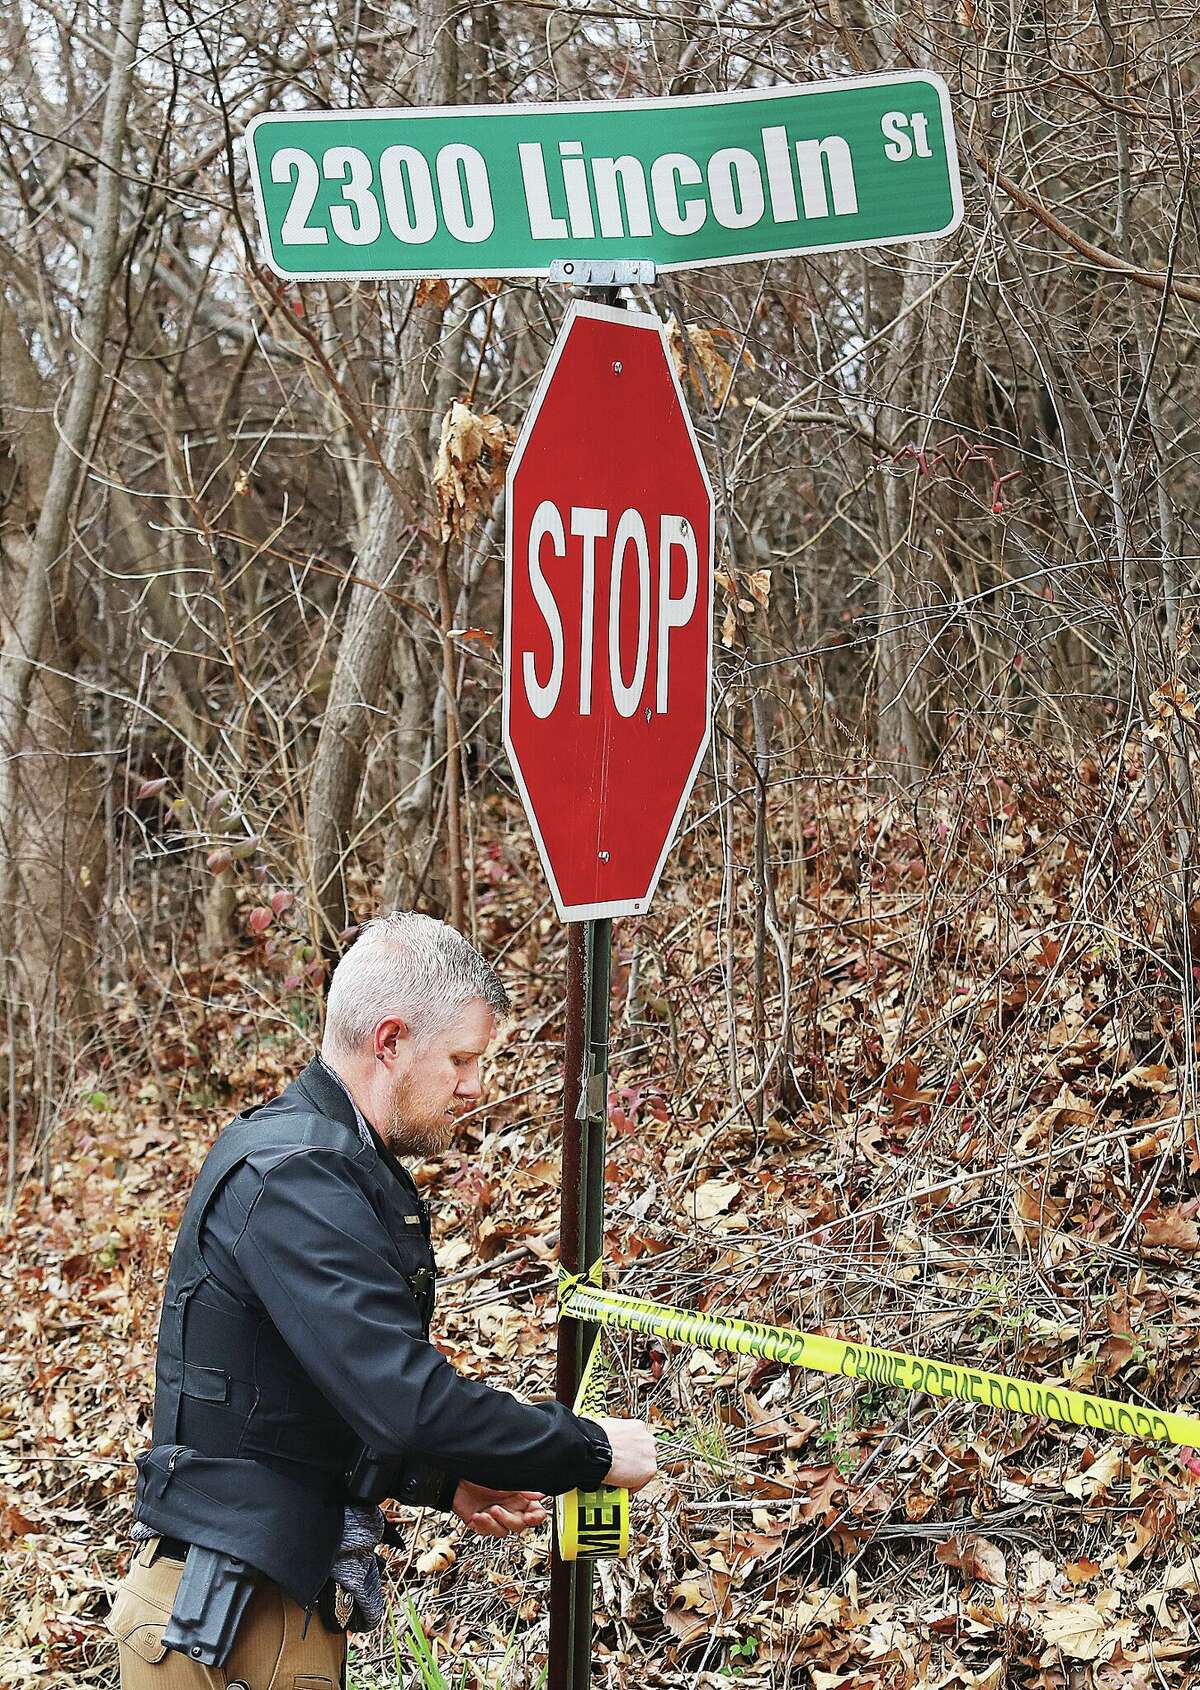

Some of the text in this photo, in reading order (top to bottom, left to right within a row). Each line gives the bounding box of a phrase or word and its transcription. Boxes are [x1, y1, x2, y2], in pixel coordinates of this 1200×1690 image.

[269, 110, 934, 246] 2300 Lincoln St
[521, 499, 700, 720] STOP
